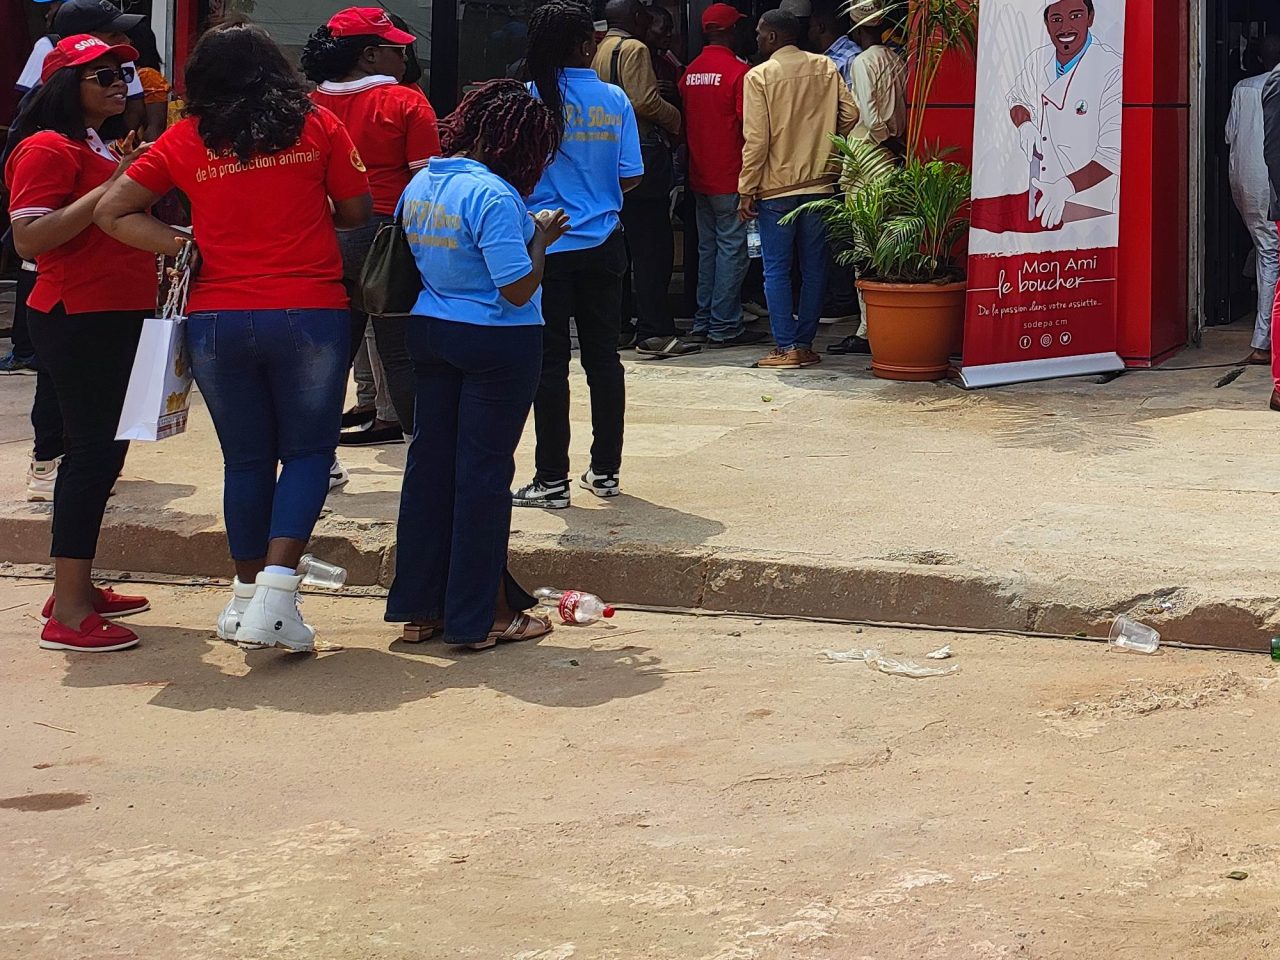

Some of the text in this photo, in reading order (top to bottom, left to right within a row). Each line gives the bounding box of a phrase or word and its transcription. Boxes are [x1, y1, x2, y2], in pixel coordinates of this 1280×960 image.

[685, 73, 722, 86] SECURITE
[208, 165, 217, 178] la
[219, 156, 276, 179] production
[279, 149, 321, 166] animale
[1022, 256, 1098, 275] Mon Ami
[998, 270, 1085, 298] le boucher
[977, 304, 990, 316] De
[992, 304, 999, 317] la
[1000, 305, 1027, 319] passion
[1029, 301, 1047, 311] dans
[1048, 301, 1067, 310] votre
